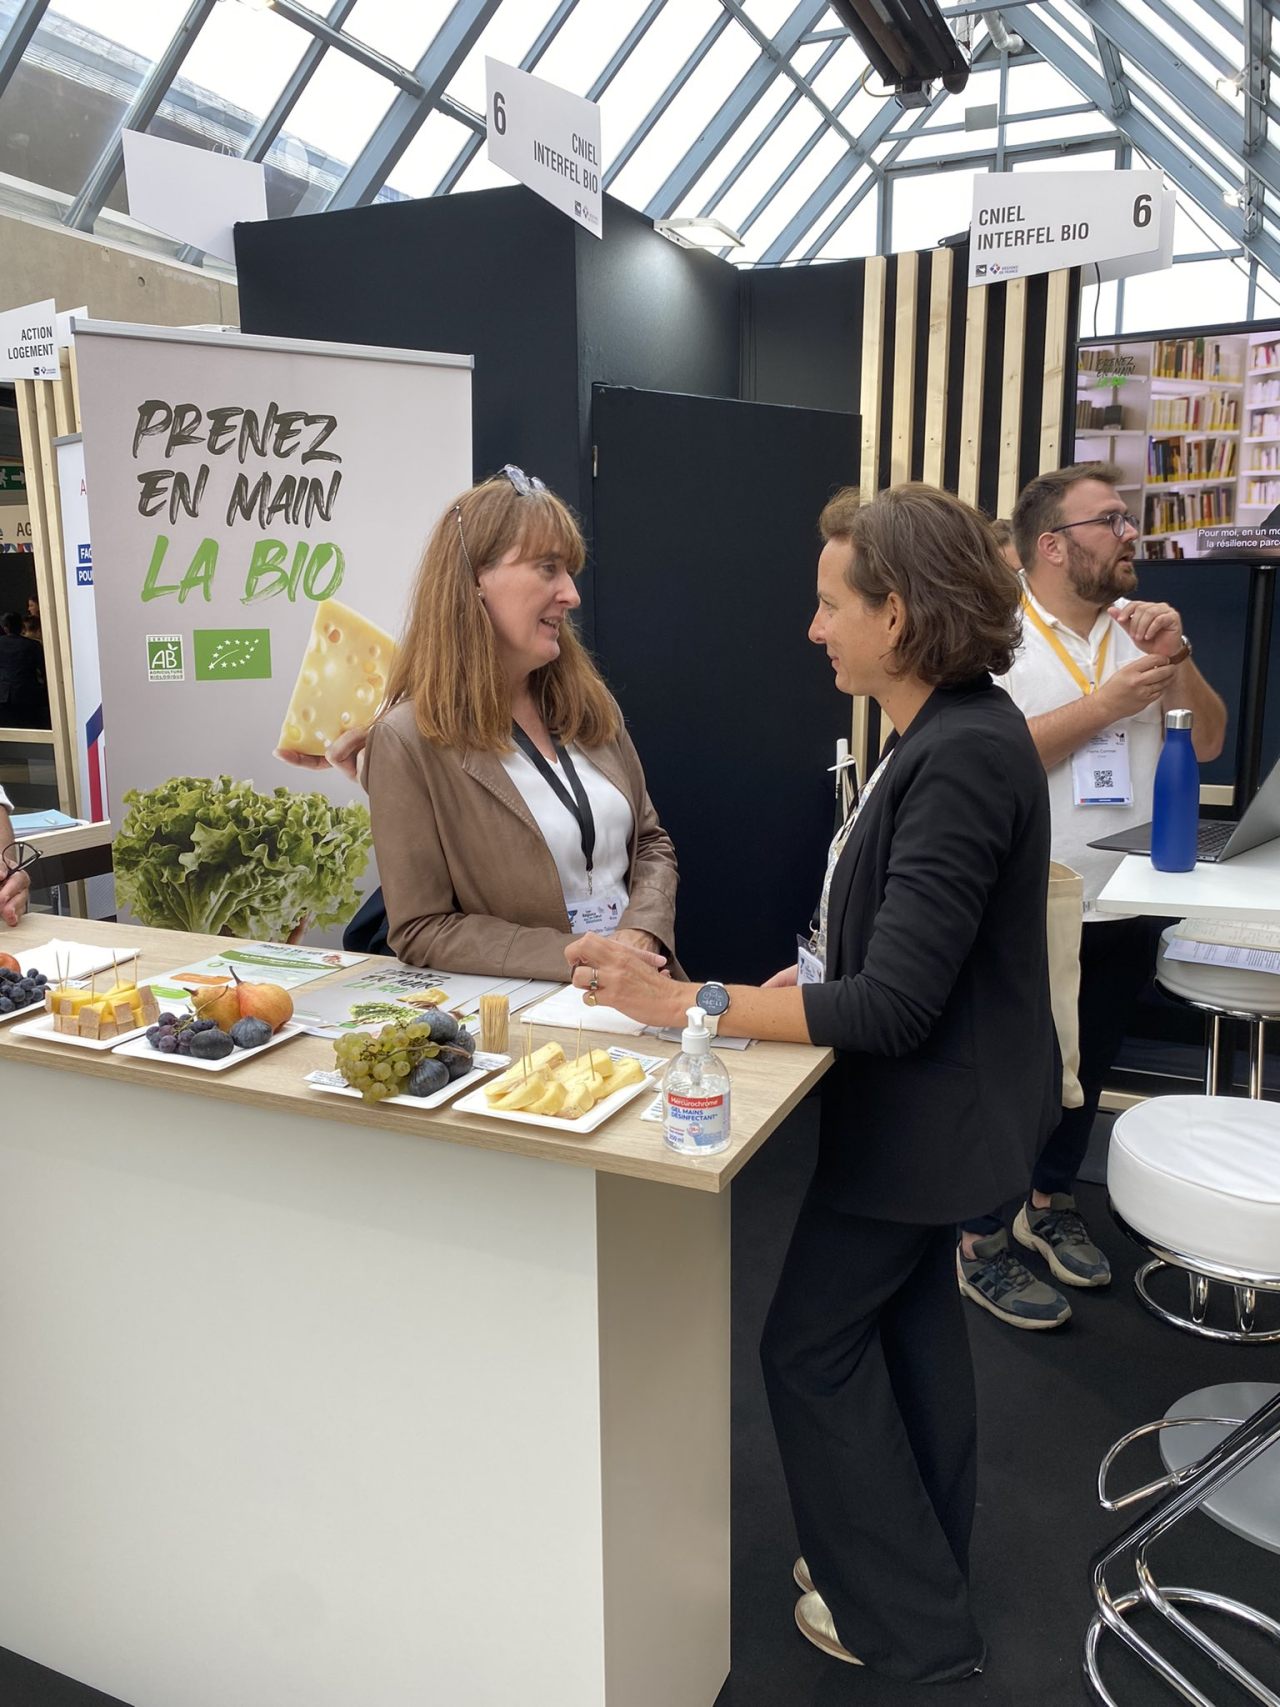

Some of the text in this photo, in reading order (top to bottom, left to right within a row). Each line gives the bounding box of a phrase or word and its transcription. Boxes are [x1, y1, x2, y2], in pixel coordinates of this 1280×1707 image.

[493, 91, 506, 135] 6
[572, 133, 598, 166] CNIEL
[534, 140, 598, 194] INTERFEL BIO
[979, 205, 1025, 226] CNIEL
[1133, 193, 1153, 228] 6
[977, 222, 1090, 251] INTERFEL BIO
[21, 326, 53, 341] ACTION
[8, 343, 54, 360] LOGEMENT
[132, 399, 342, 465] PRENEZ
[137, 464, 342, 530] EN MAIN
[1198, 528, 1219, 538] Pour
[1221, 528, 1239, 537] moi,
[1255, 528, 1266, 536] un
[1206, 540, 1214, 548] la
[1217, 539, 1257, 548] résilience
[140, 535, 345, 607] LA BIO
[151, 649, 177, 669] AB
